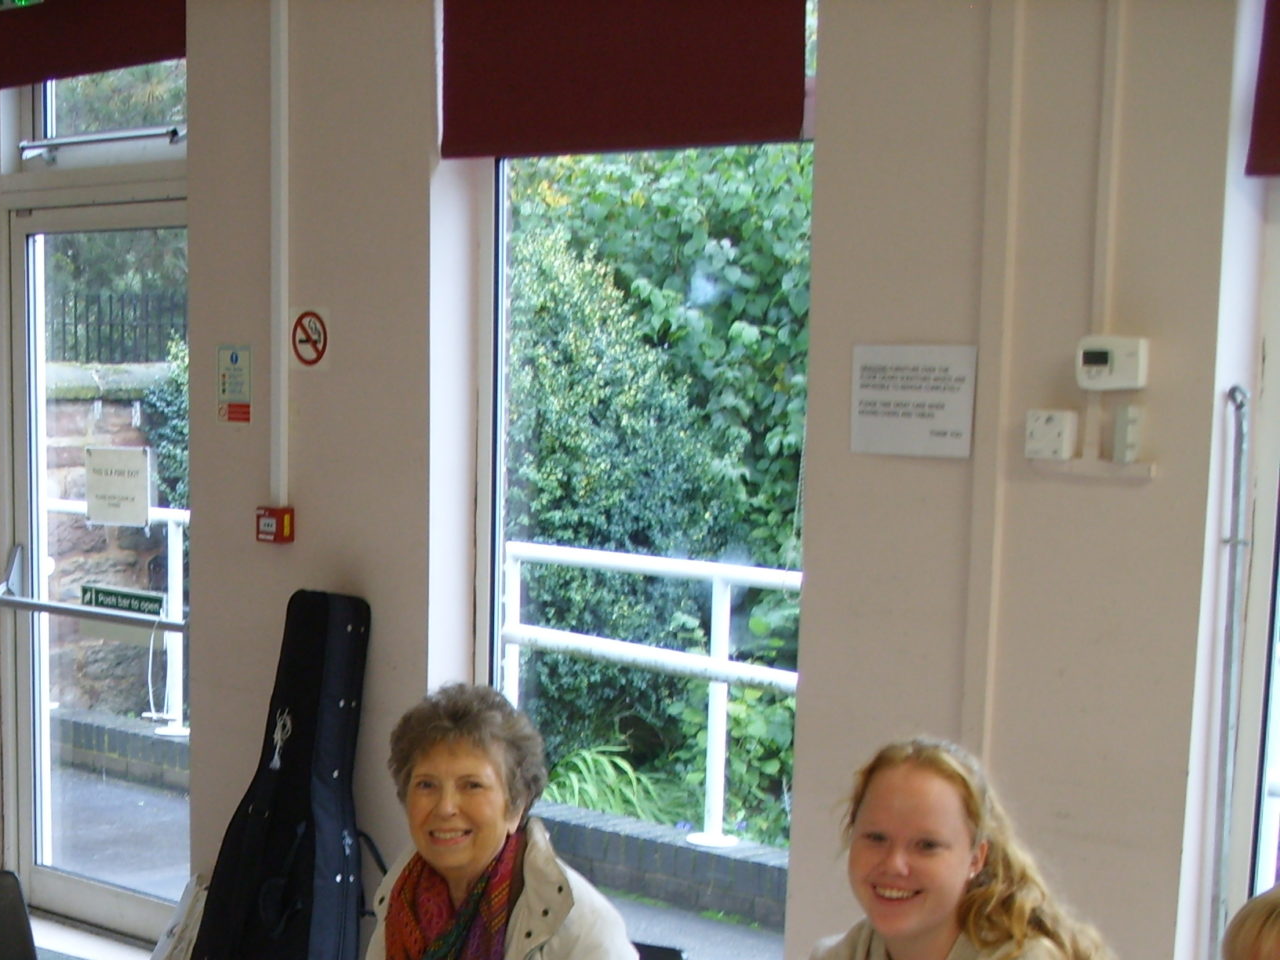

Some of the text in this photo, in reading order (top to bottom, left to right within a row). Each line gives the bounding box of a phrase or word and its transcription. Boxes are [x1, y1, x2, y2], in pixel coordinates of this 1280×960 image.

[97, 592, 161, 615] Push bar to open
